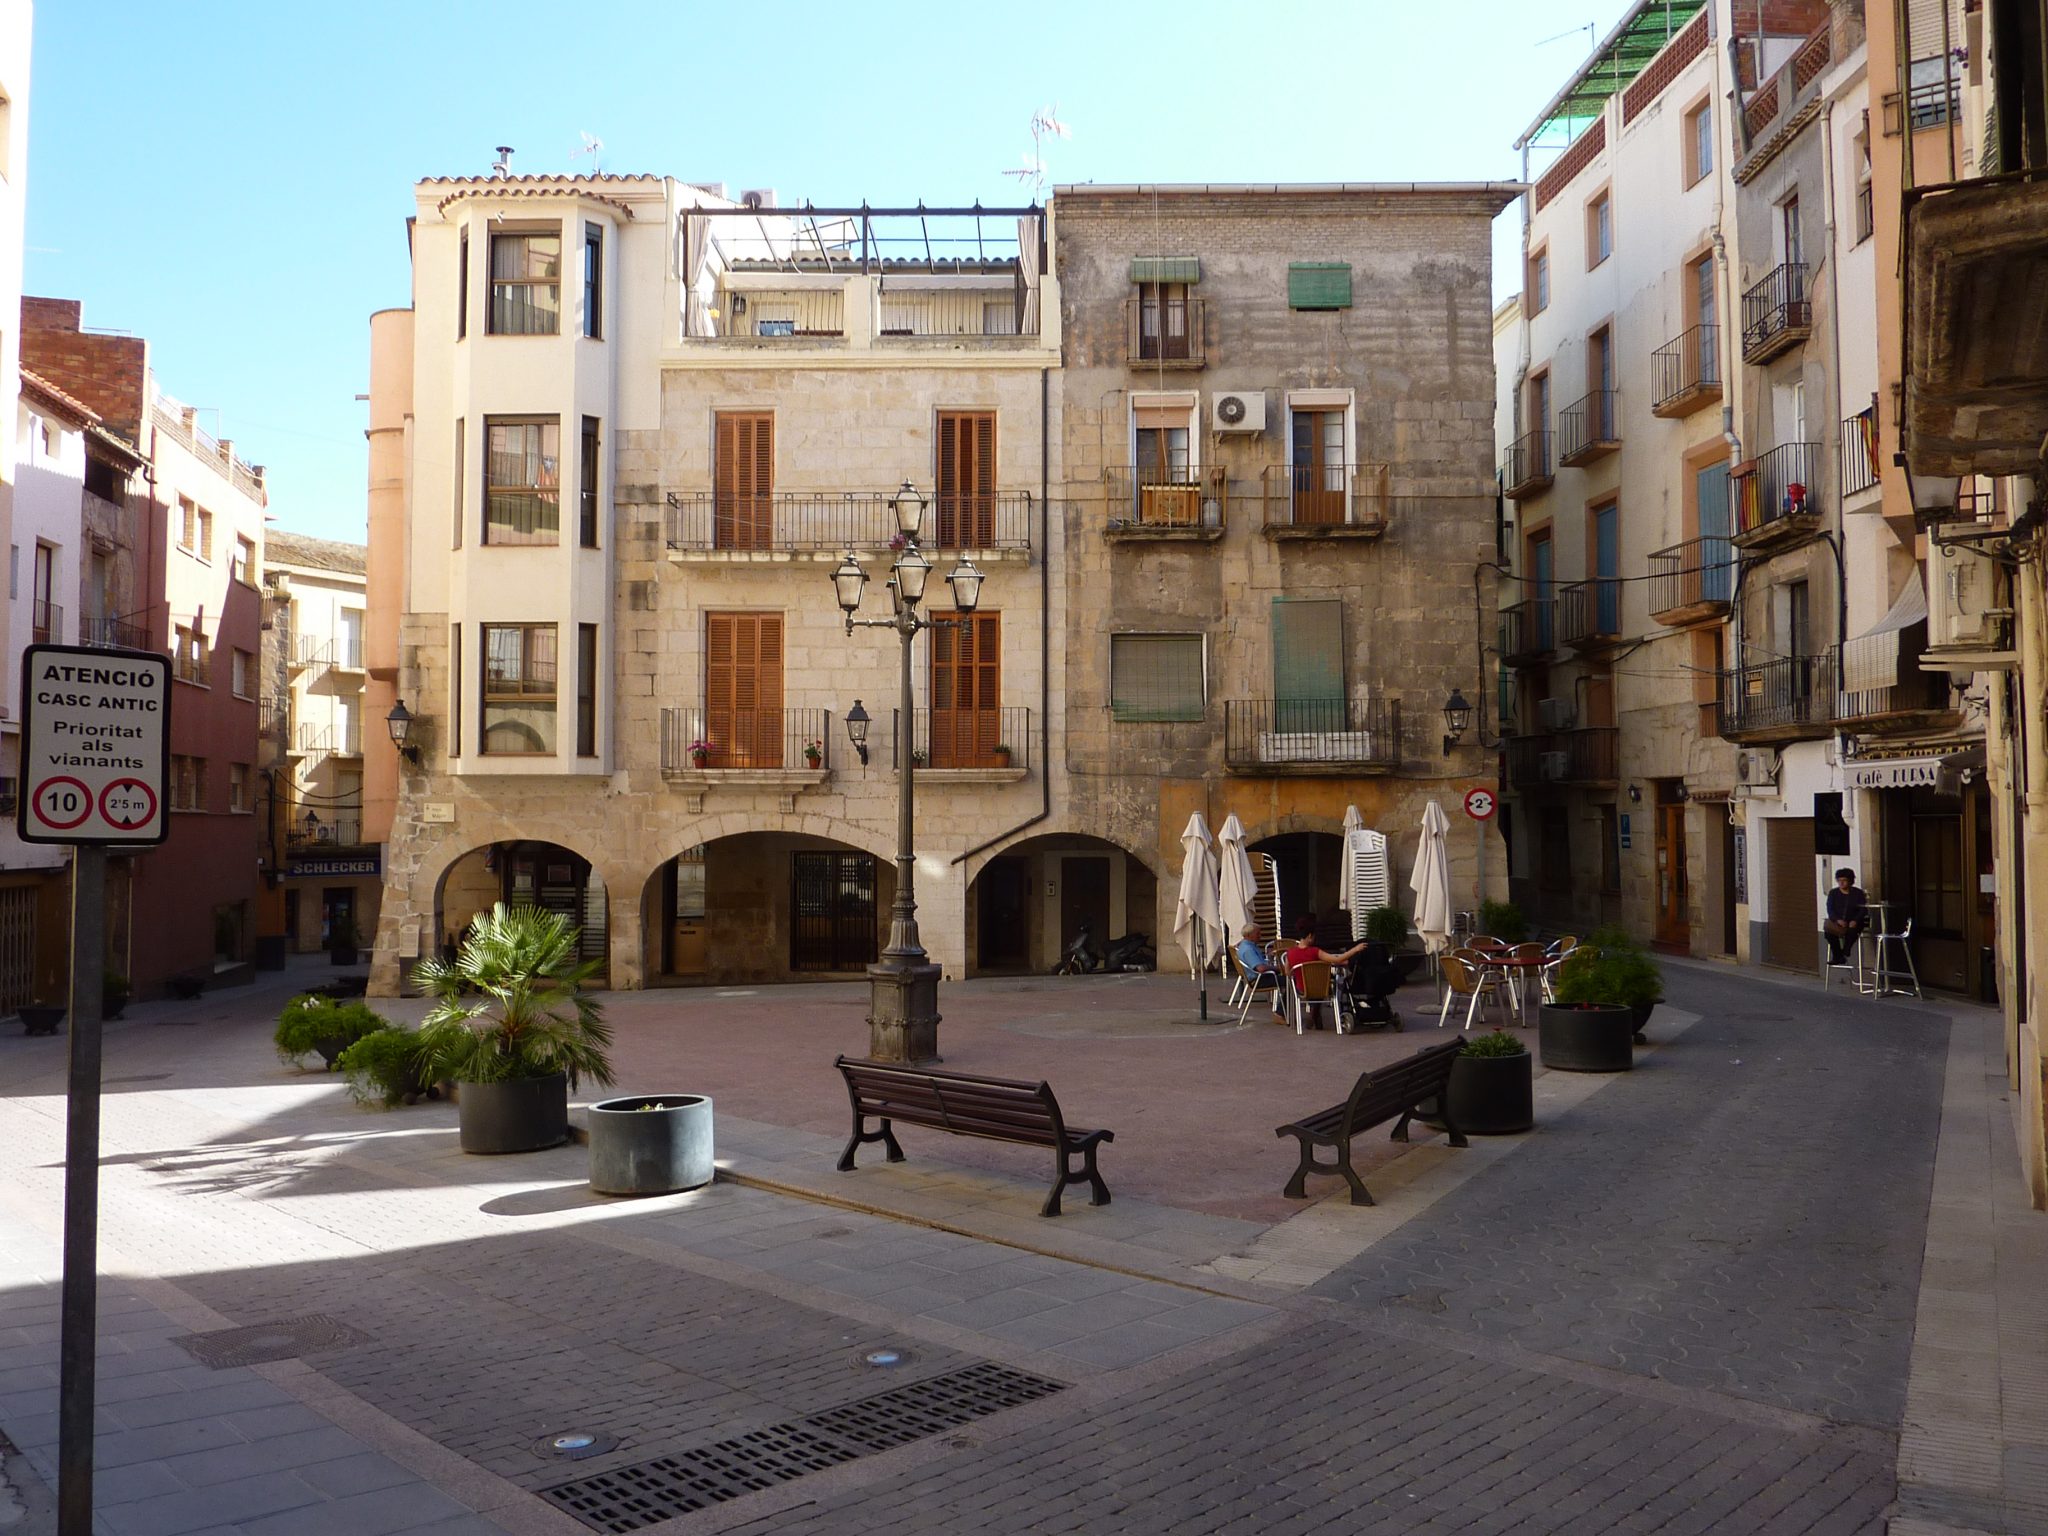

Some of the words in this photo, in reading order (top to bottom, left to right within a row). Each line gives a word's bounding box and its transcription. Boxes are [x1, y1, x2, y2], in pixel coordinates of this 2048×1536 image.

[43, 665, 155, 688] ATENCIÓ
[37, 692, 91, 707] CASC
[98, 697, 158, 712] ANTIC
[53, 721, 143, 739] Prioritat
[82, 739, 113, 752] als
[49, 753, 144, 769] vianants
[47, 792, 77, 812] 10
[133, 802, 145, 810] m
[1475, 798, 1483, 809] 2
[293, 862, 375, 874] SCHLECKER
[1737, 836, 1745, 904] RESTAURANT
